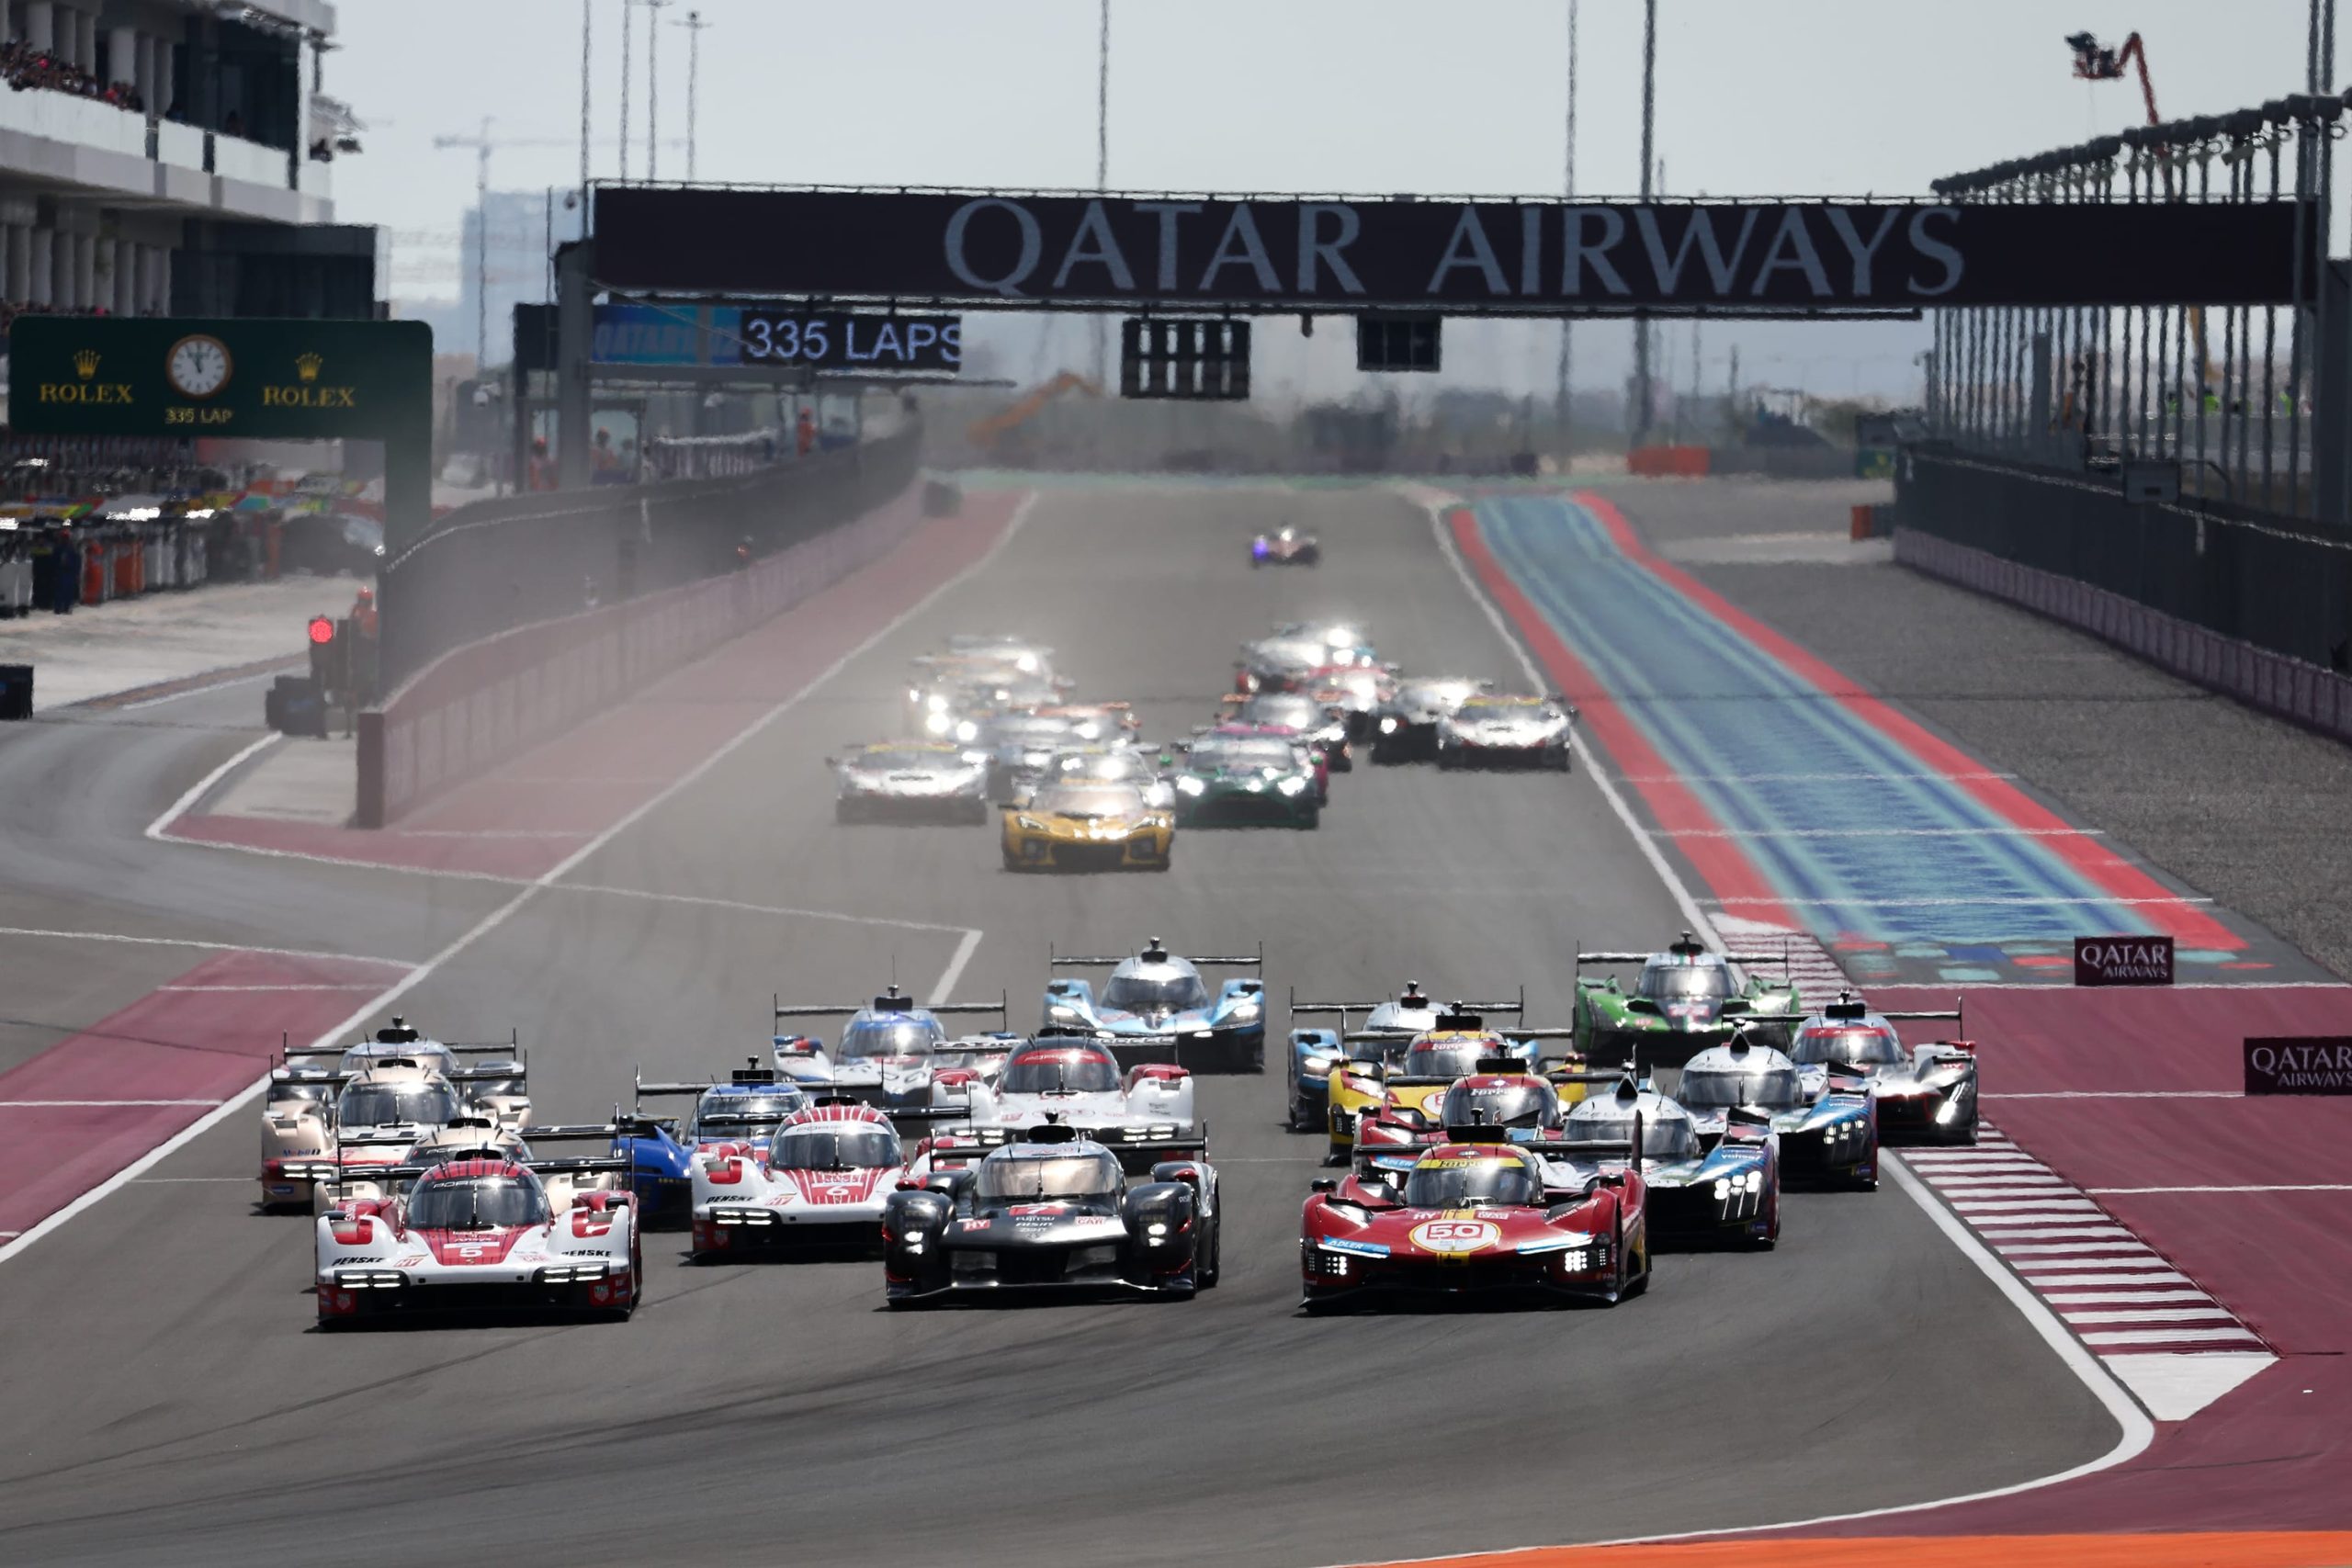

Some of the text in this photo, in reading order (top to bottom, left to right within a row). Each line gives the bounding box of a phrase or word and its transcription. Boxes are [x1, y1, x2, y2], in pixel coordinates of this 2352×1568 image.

[944, 198, 1963, 296] QATAR AIRWAYS
[746, 318, 829, 359] 335
[845, 321, 961, 362] LAPS
[40, 384, 135, 404] ROLEX
[263, 386, 356, 407] ROLEX
[200, 408, 233, 424] LAP
[2081, 944, 2167, 969] QATAR
[2102, 964, 2167, 978] AIRWAYS
[2251, 1045, 2352, 1076] QATAR
[2278, 1072, 2352, 1088] AIRWAYS
[433, 1179, 518, 1189] PORSE
[825, 1184, 849, 1196] 6
[1413, 1211, 1437, 1220] HY
[965, 1220, 989, 1231] HY
[1429, 1224, 1481, 1238] 50
[1329, 1239, 1364, 1250] ADLER
[459, 1247, 483, 1258] 5
[331, 1257, 386, 1267] PENSKE
